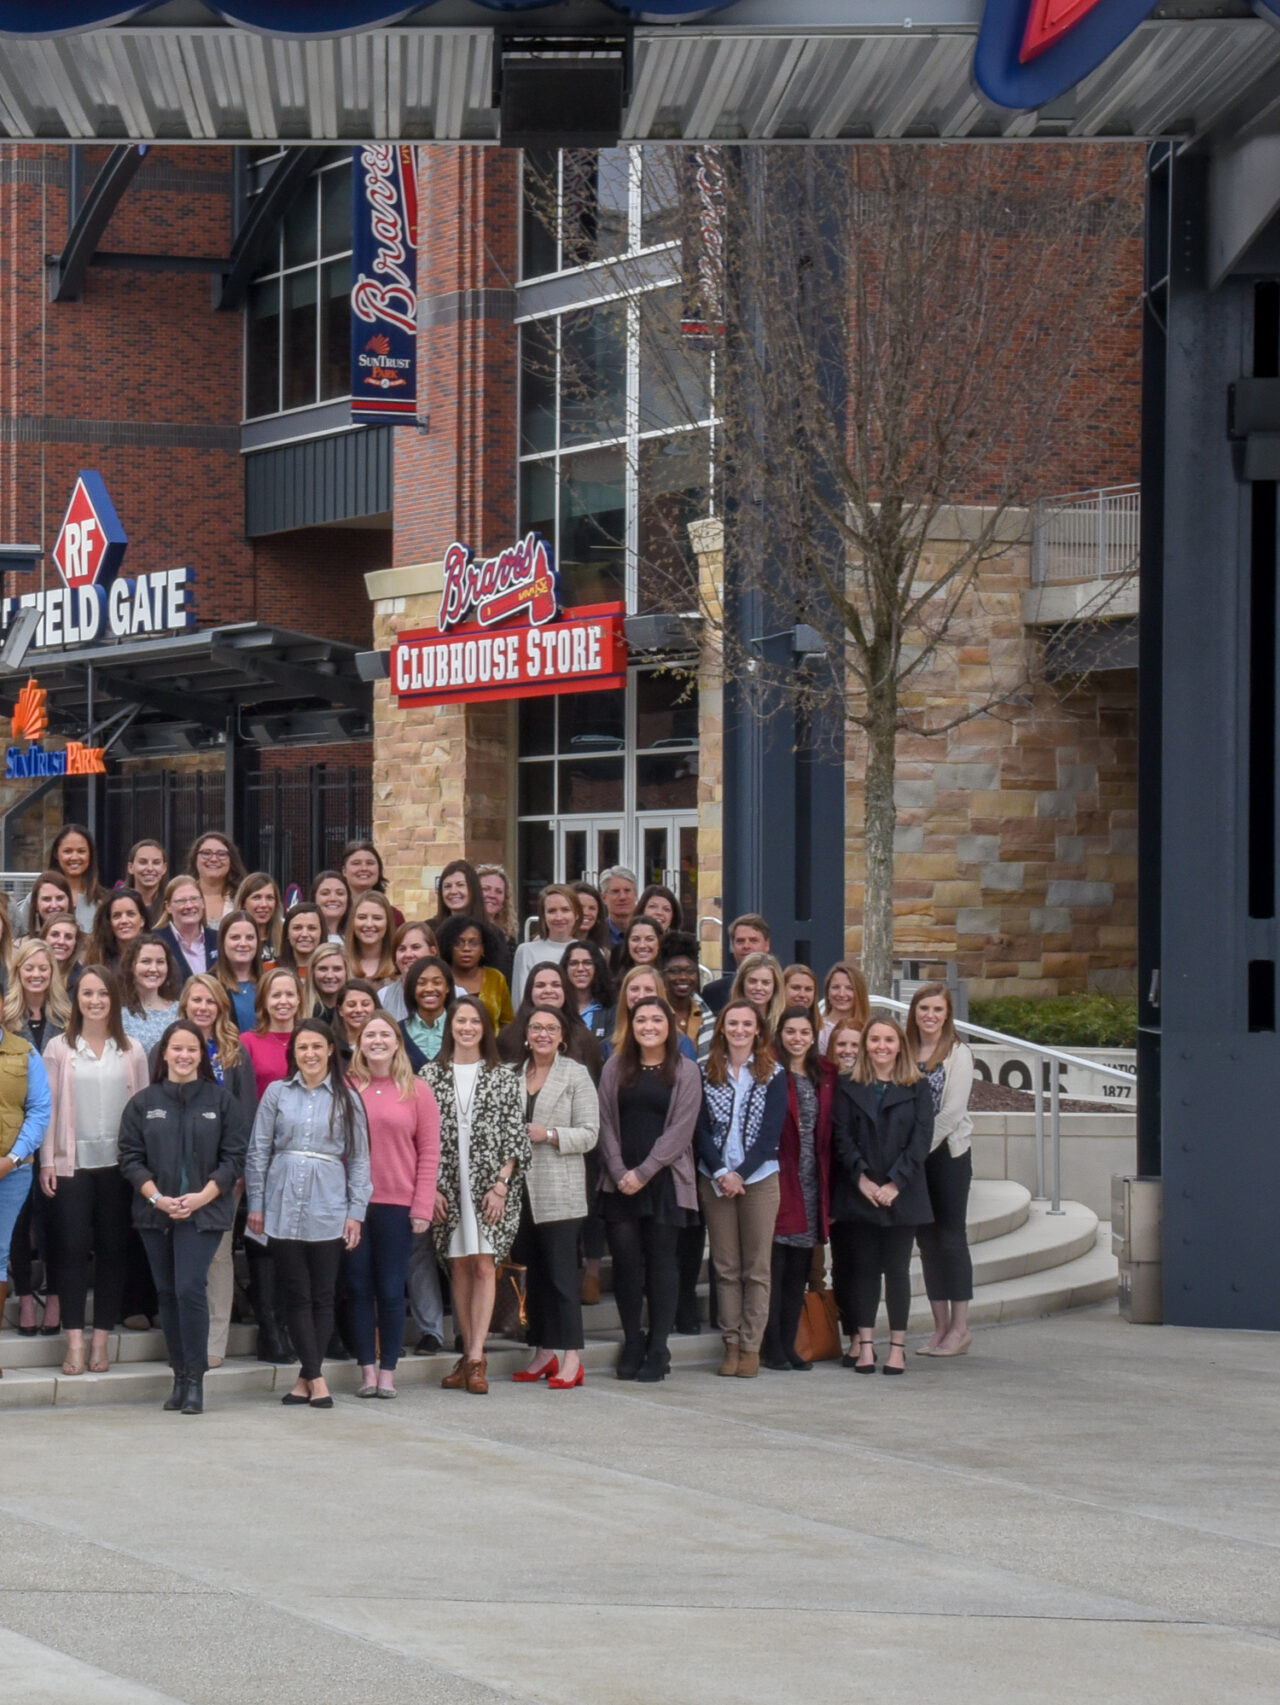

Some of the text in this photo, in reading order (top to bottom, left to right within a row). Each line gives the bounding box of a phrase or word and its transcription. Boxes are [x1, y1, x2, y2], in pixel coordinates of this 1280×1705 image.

[65, 518, 96, 579] RF
[438, 531, 537, 632] Braves
[109, 568, 187, 636] GATE
[396, 624, 602, 691] CLUBHOUSE STORE
[1102, 1085, 1131, 1099] 1877
